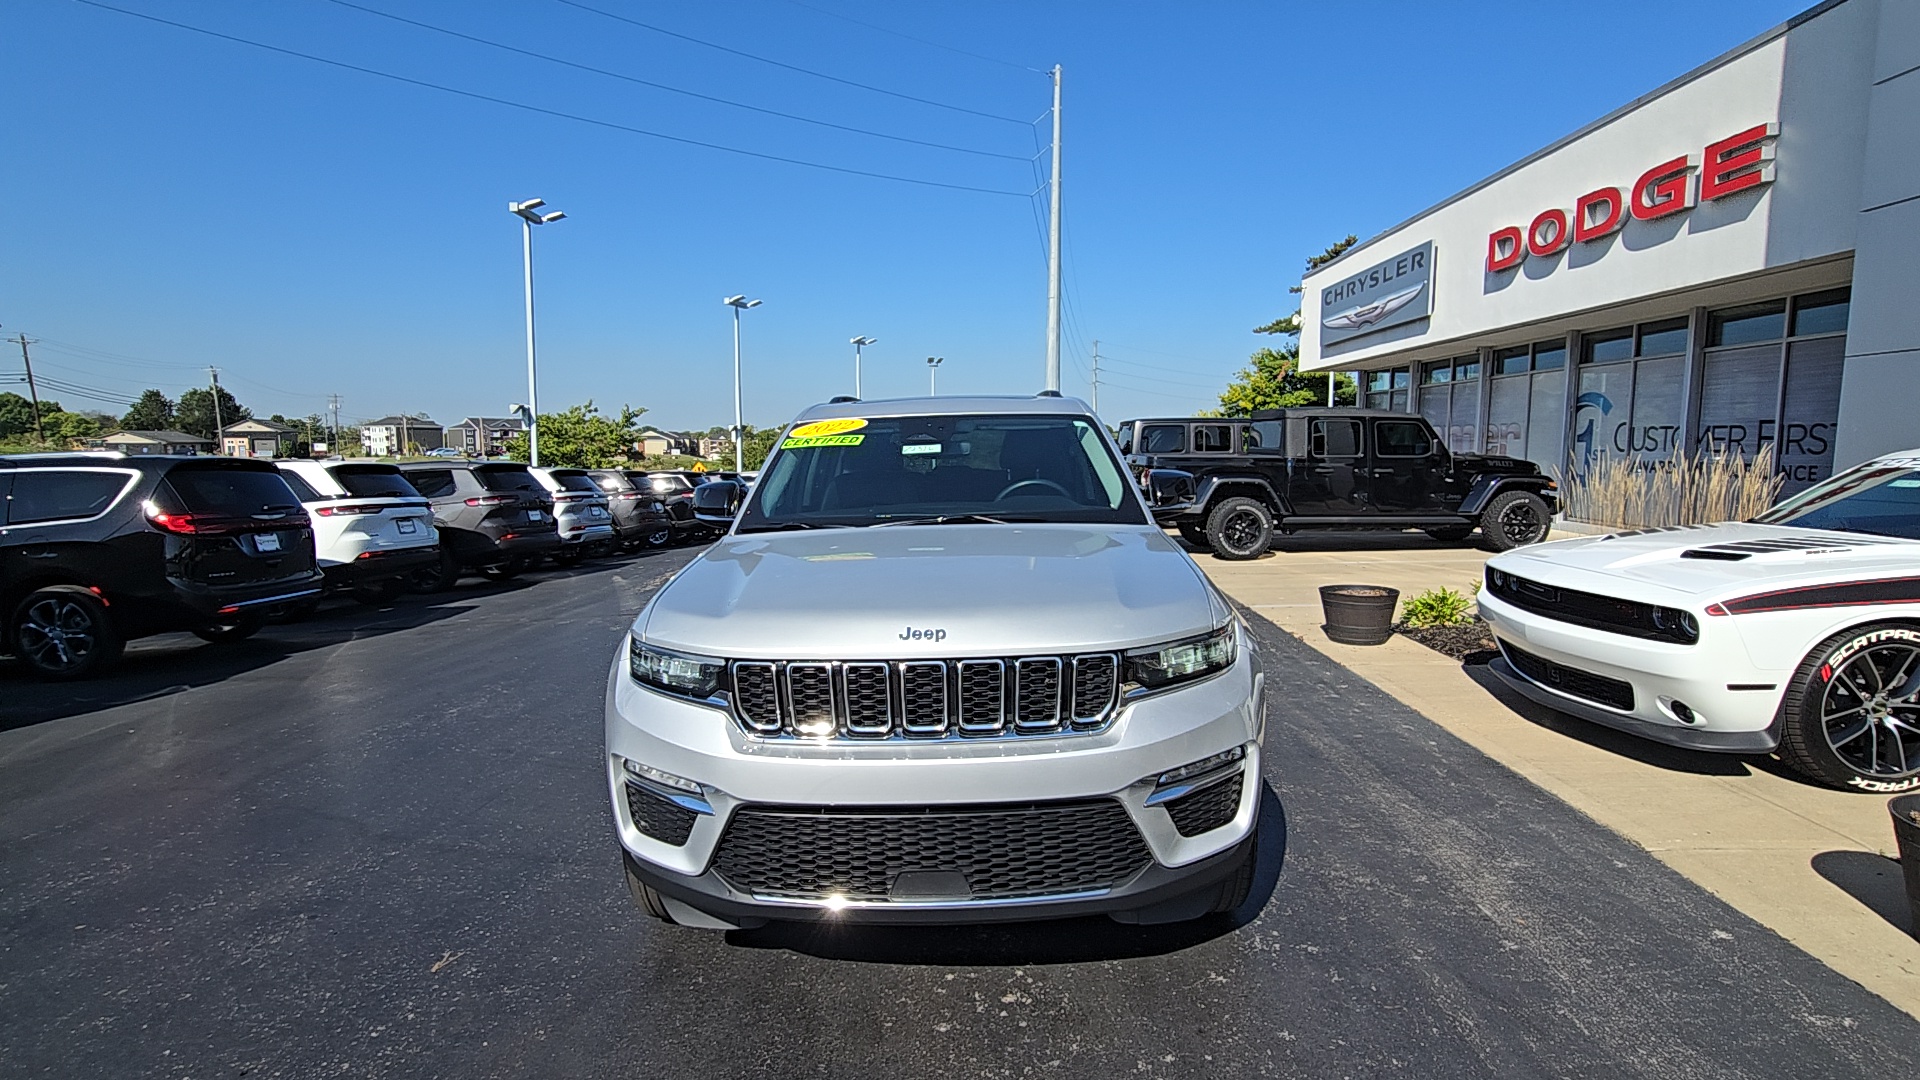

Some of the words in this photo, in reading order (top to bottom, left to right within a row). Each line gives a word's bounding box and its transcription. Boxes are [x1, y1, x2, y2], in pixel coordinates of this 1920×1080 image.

[1487, 122, 1775, 273] DODGE
[1324, 251, 1425, 306] CHRYSLER
[802, 420, 855, 436] 2022
[1756, 419, 1837, 456] FIRS
[783, 435, 861, 448] CERTIFIED
[898, 626, 947, 642] Jeep
